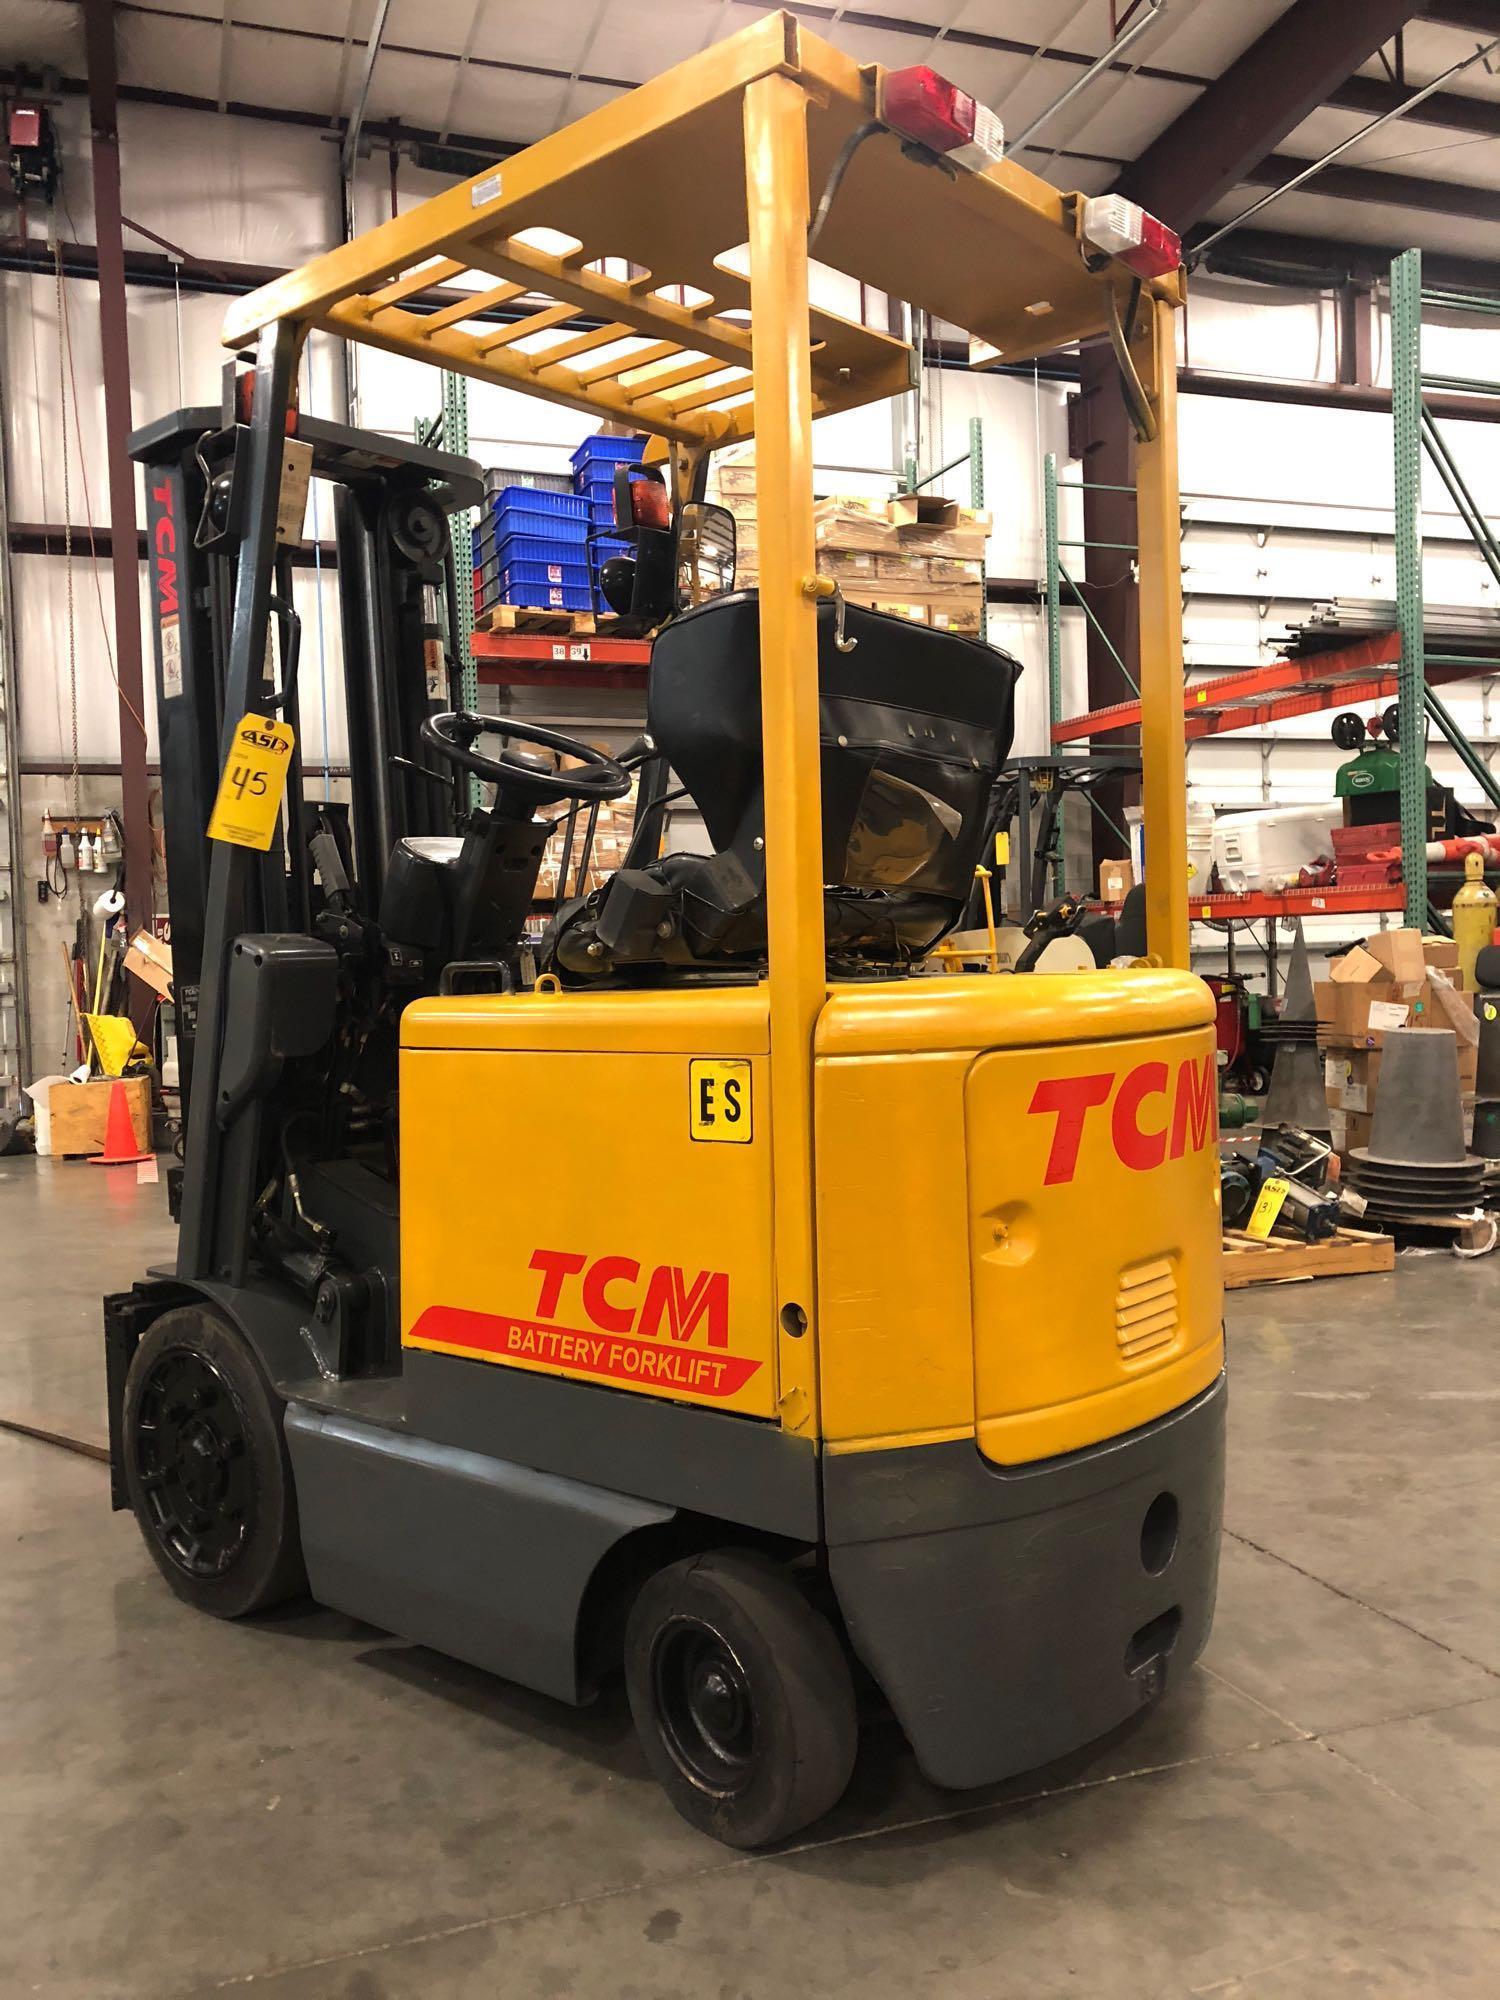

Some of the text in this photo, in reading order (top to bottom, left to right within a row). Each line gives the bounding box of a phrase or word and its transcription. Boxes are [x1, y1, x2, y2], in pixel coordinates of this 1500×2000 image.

[153, 478, 179, 614] TCM
[231, 766, 269, 801] 45
[700, 1078, 741, 1123] ES
[1027, 1054, 1218, 1186] TCM
[528, 1249, 729, 1349] TCM
[507, 1325, 728, 1389] BATTERY FORKLIFT
